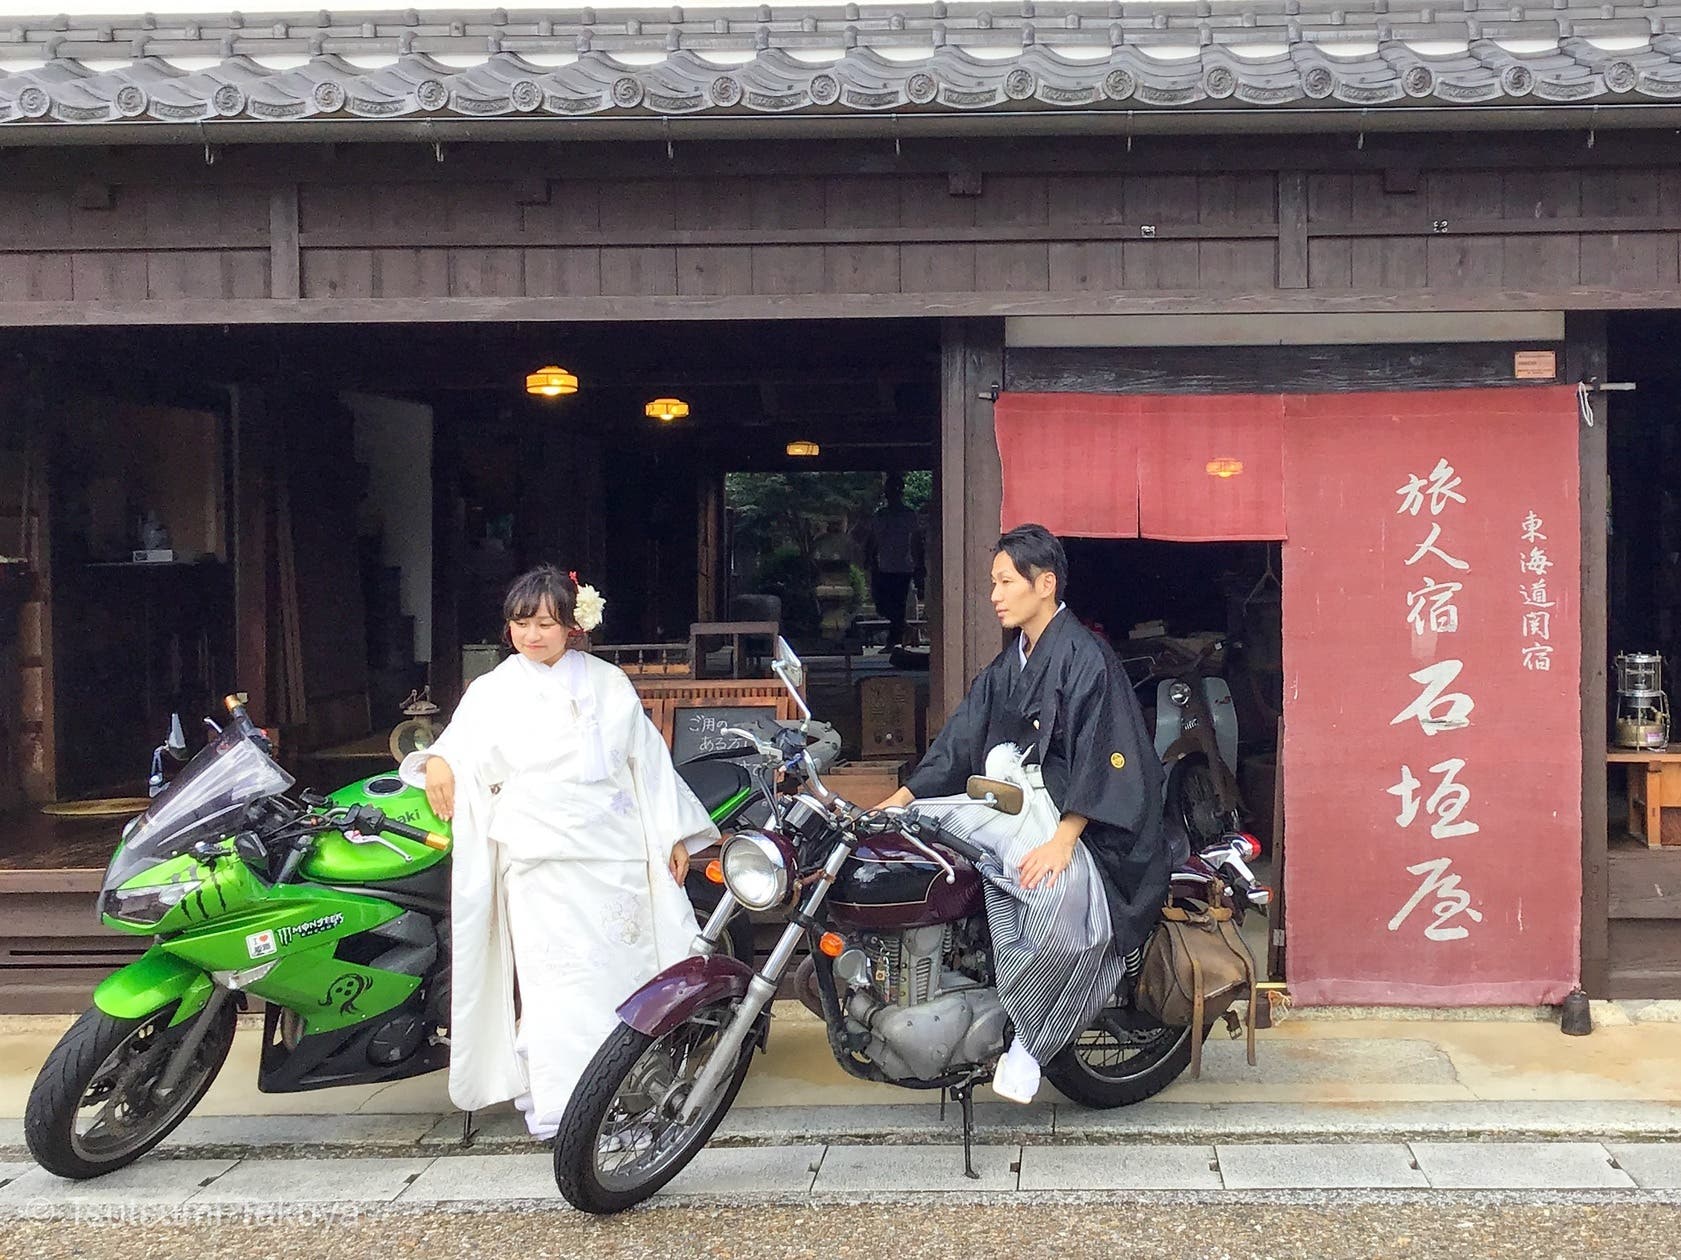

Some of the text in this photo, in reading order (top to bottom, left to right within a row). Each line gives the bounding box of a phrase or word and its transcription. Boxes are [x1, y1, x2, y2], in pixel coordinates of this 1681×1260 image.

[1519, 509, 1556, 672] 東海道関宿
[689, 715, 728, 733] ご用の
[699, 736, 748, 752] ある方
[1385, 457, 1484, 944] 旅人宿石垣屋
